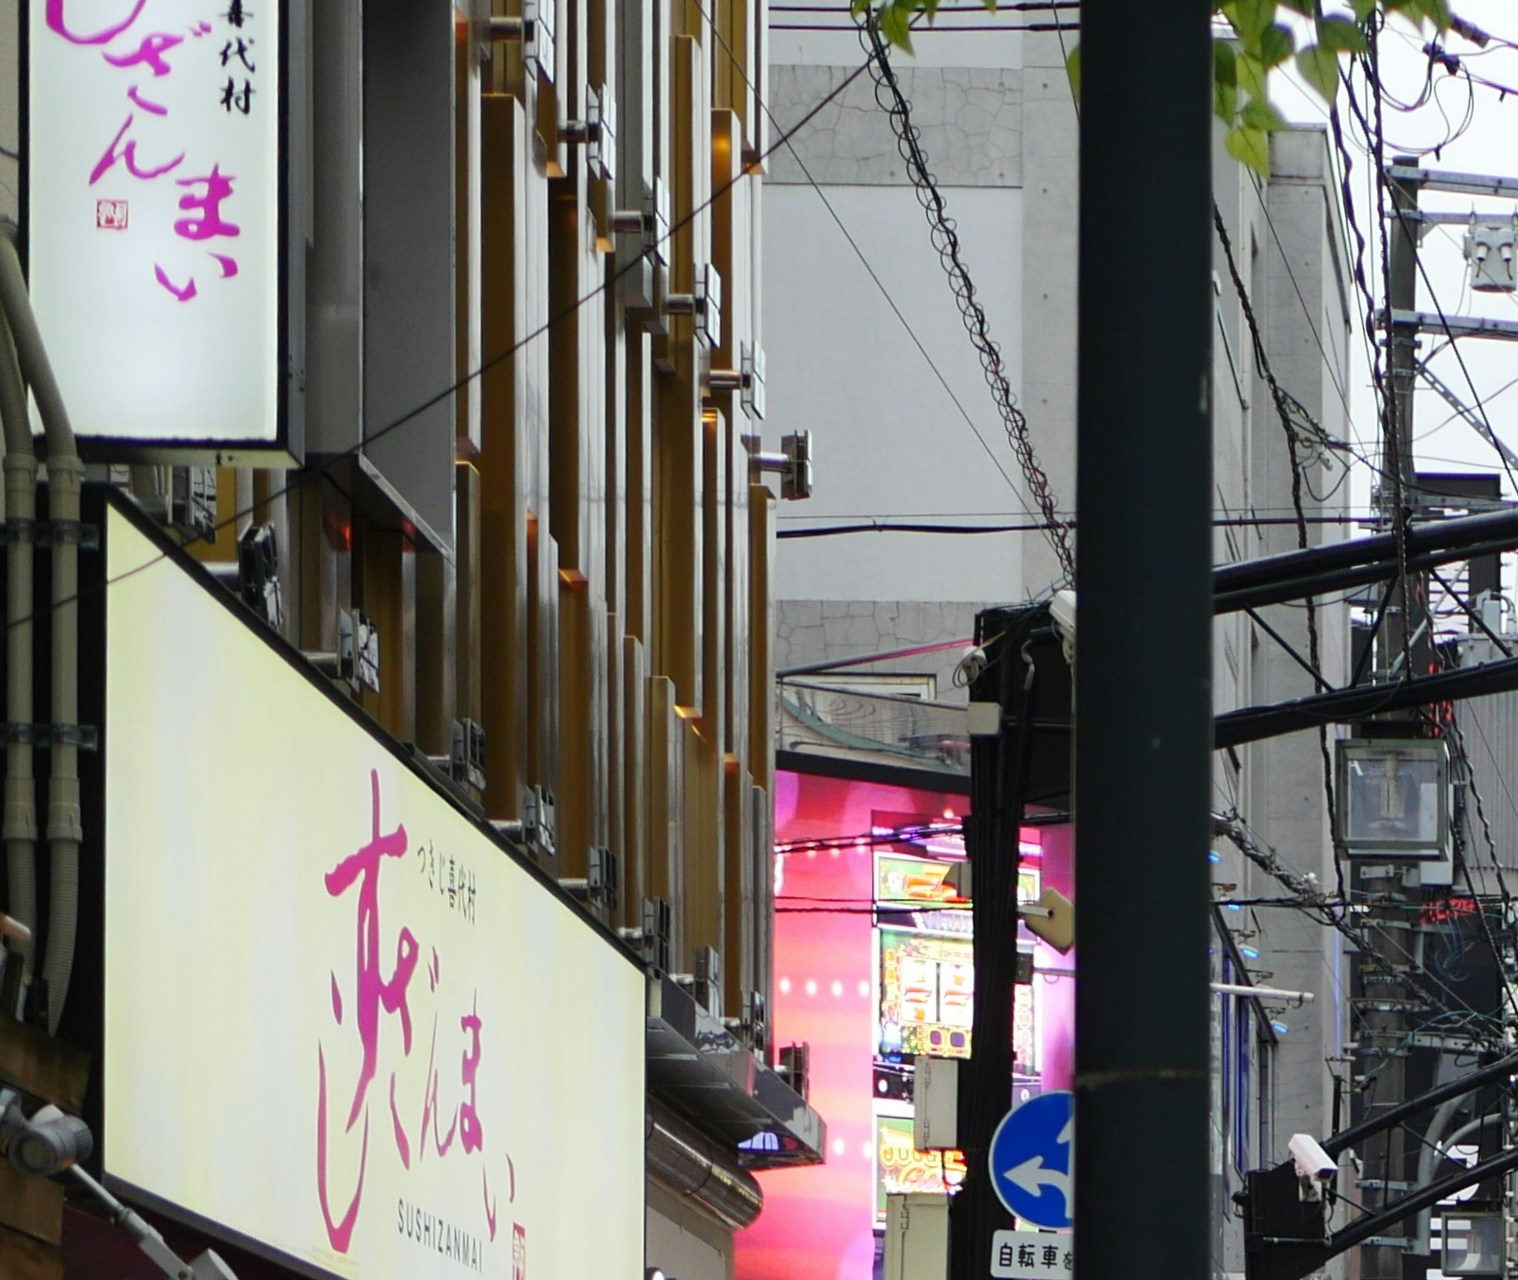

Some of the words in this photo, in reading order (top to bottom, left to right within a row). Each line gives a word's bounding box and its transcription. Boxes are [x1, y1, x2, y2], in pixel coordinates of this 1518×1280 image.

[317, 769, 515, 1254] すしざんまい
[396, 1197, 485, 1274] SUSHIZANMAI
